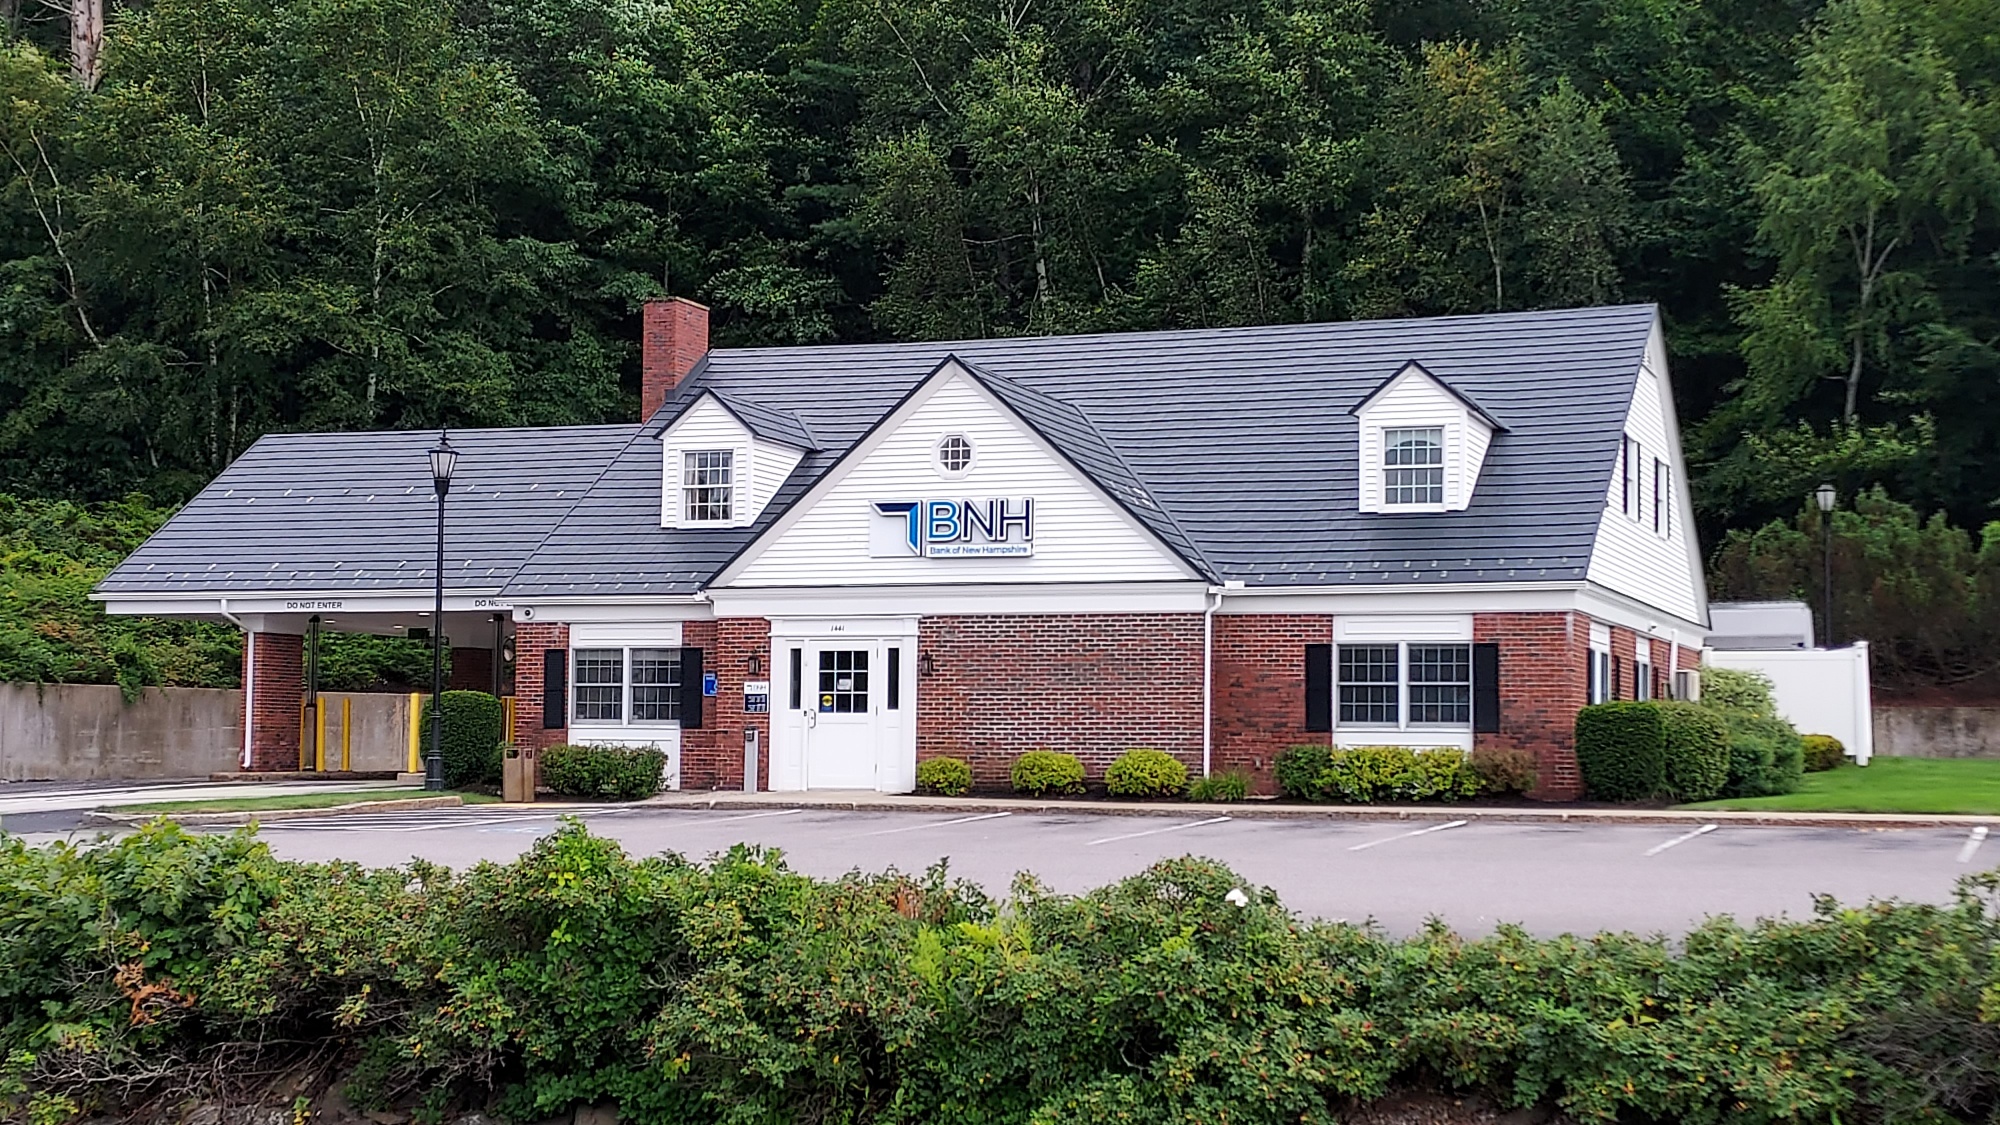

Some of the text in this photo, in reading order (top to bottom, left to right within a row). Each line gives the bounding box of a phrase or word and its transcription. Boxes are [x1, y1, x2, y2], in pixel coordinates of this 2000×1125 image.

[927, 498, 1033, 541] BNH
[930, 545, 1028, 555] Bank of New Hampshire
[287, 601, 342, 609] DO NOT ENTER
[475, 599, 487, 607] DO
